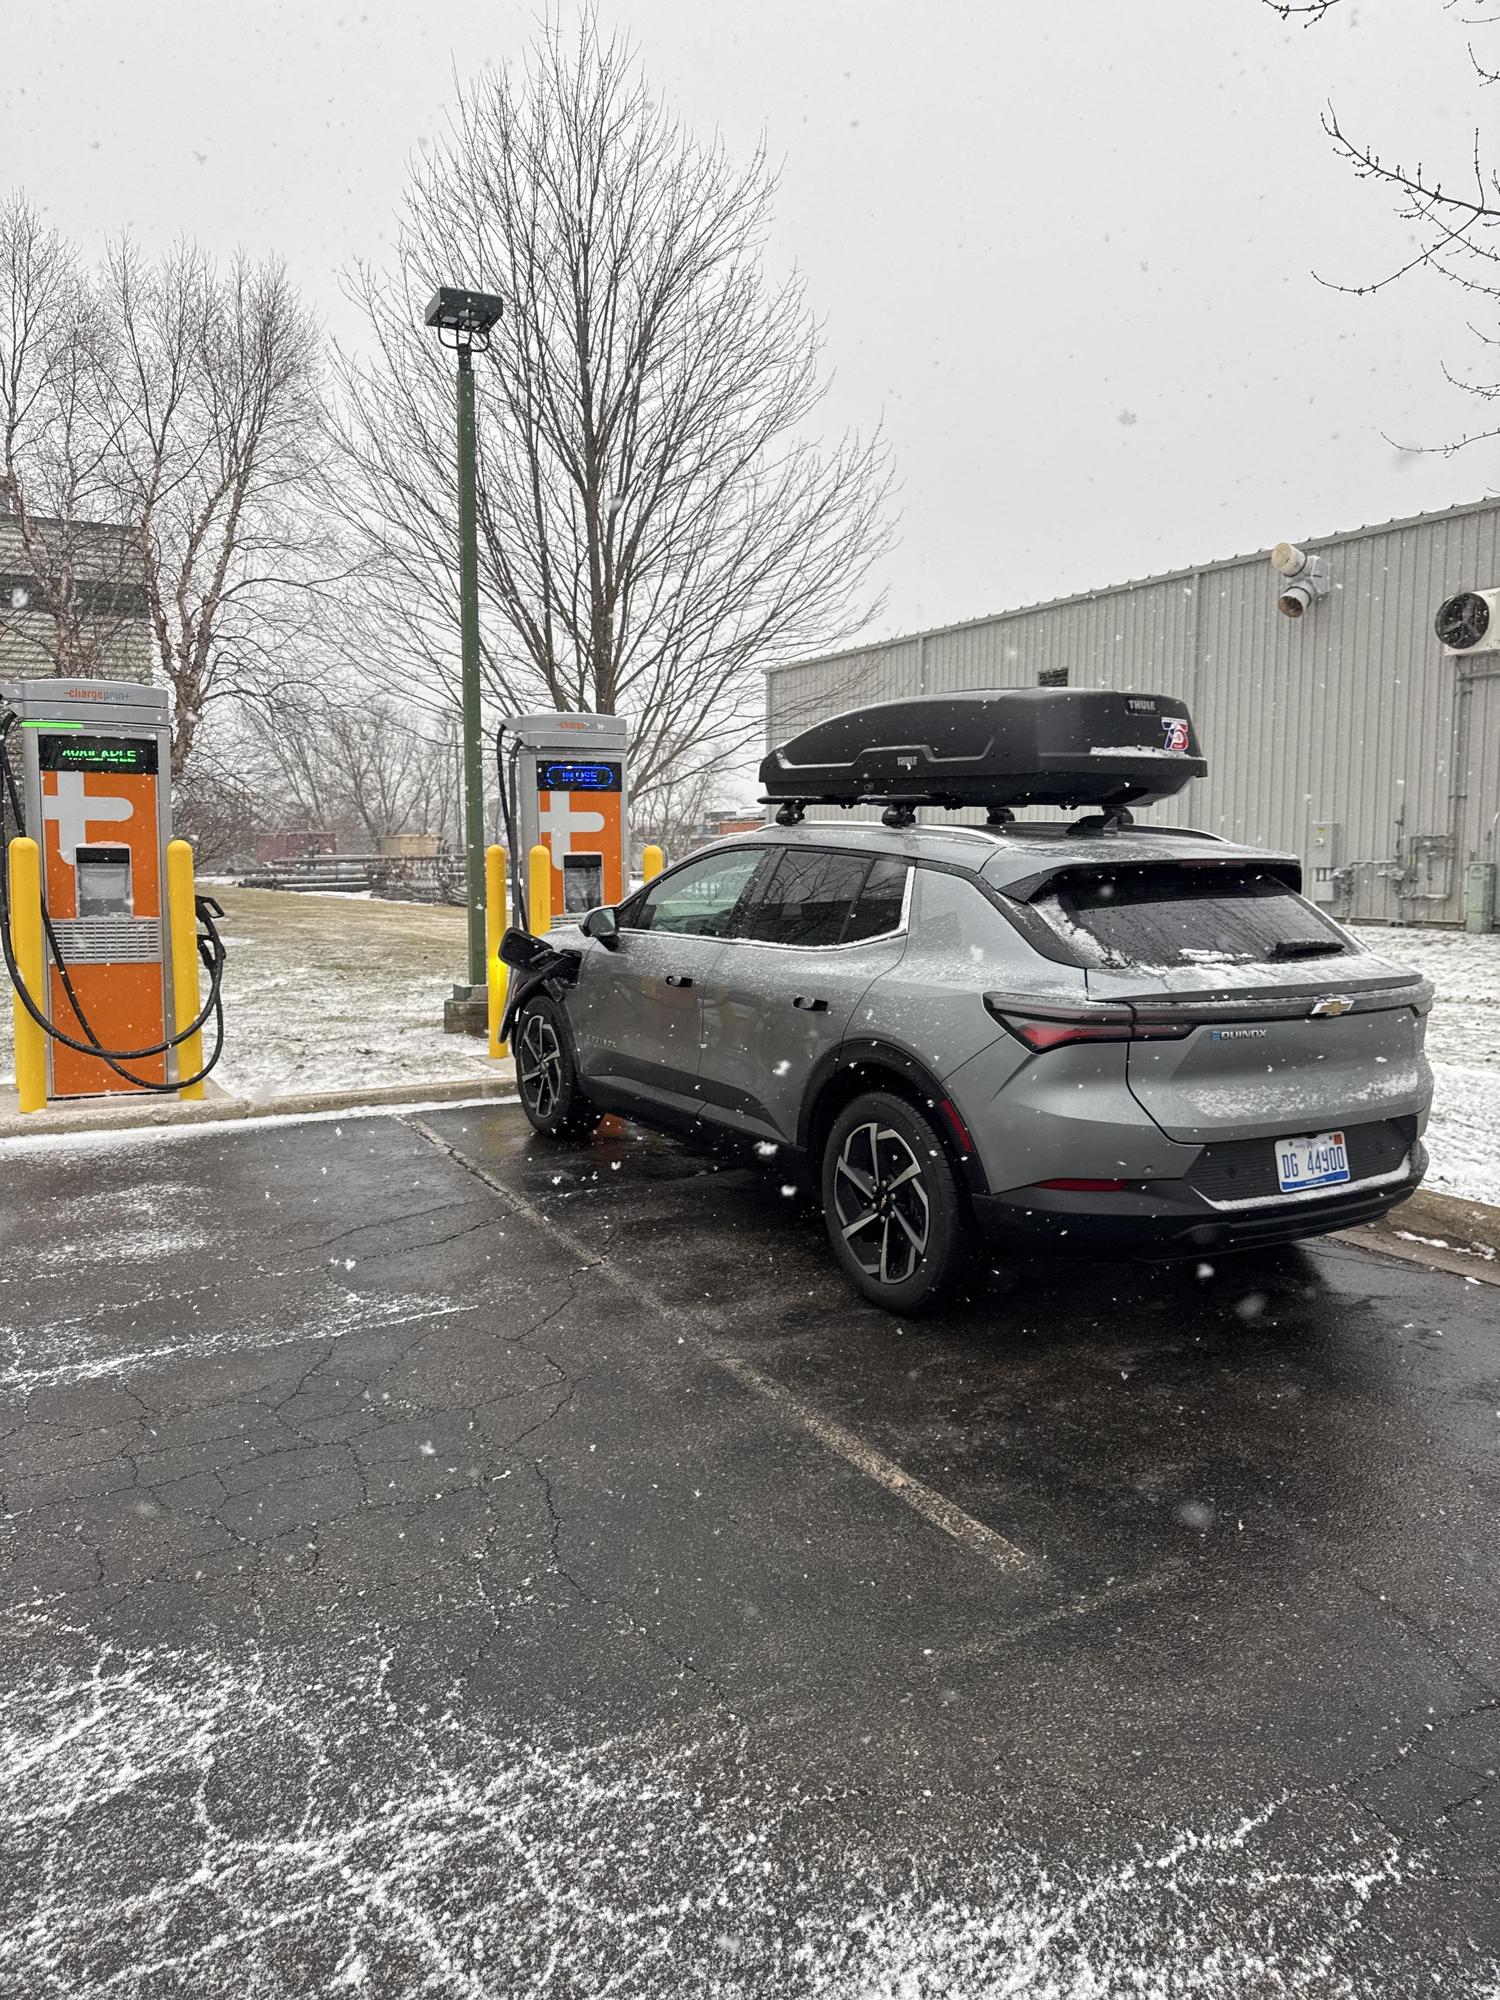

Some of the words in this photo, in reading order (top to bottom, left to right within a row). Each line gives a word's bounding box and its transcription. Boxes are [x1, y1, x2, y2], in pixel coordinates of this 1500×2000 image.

[1128, 700, 1156, 710] THULE
[896, 756, 918, 767] THULE
[1210, 1029, 1267, 1041] EQUINOX
[1281, 1153, 1299, 1178] DG
[1307, 1146, 1345, 1174] 44900
